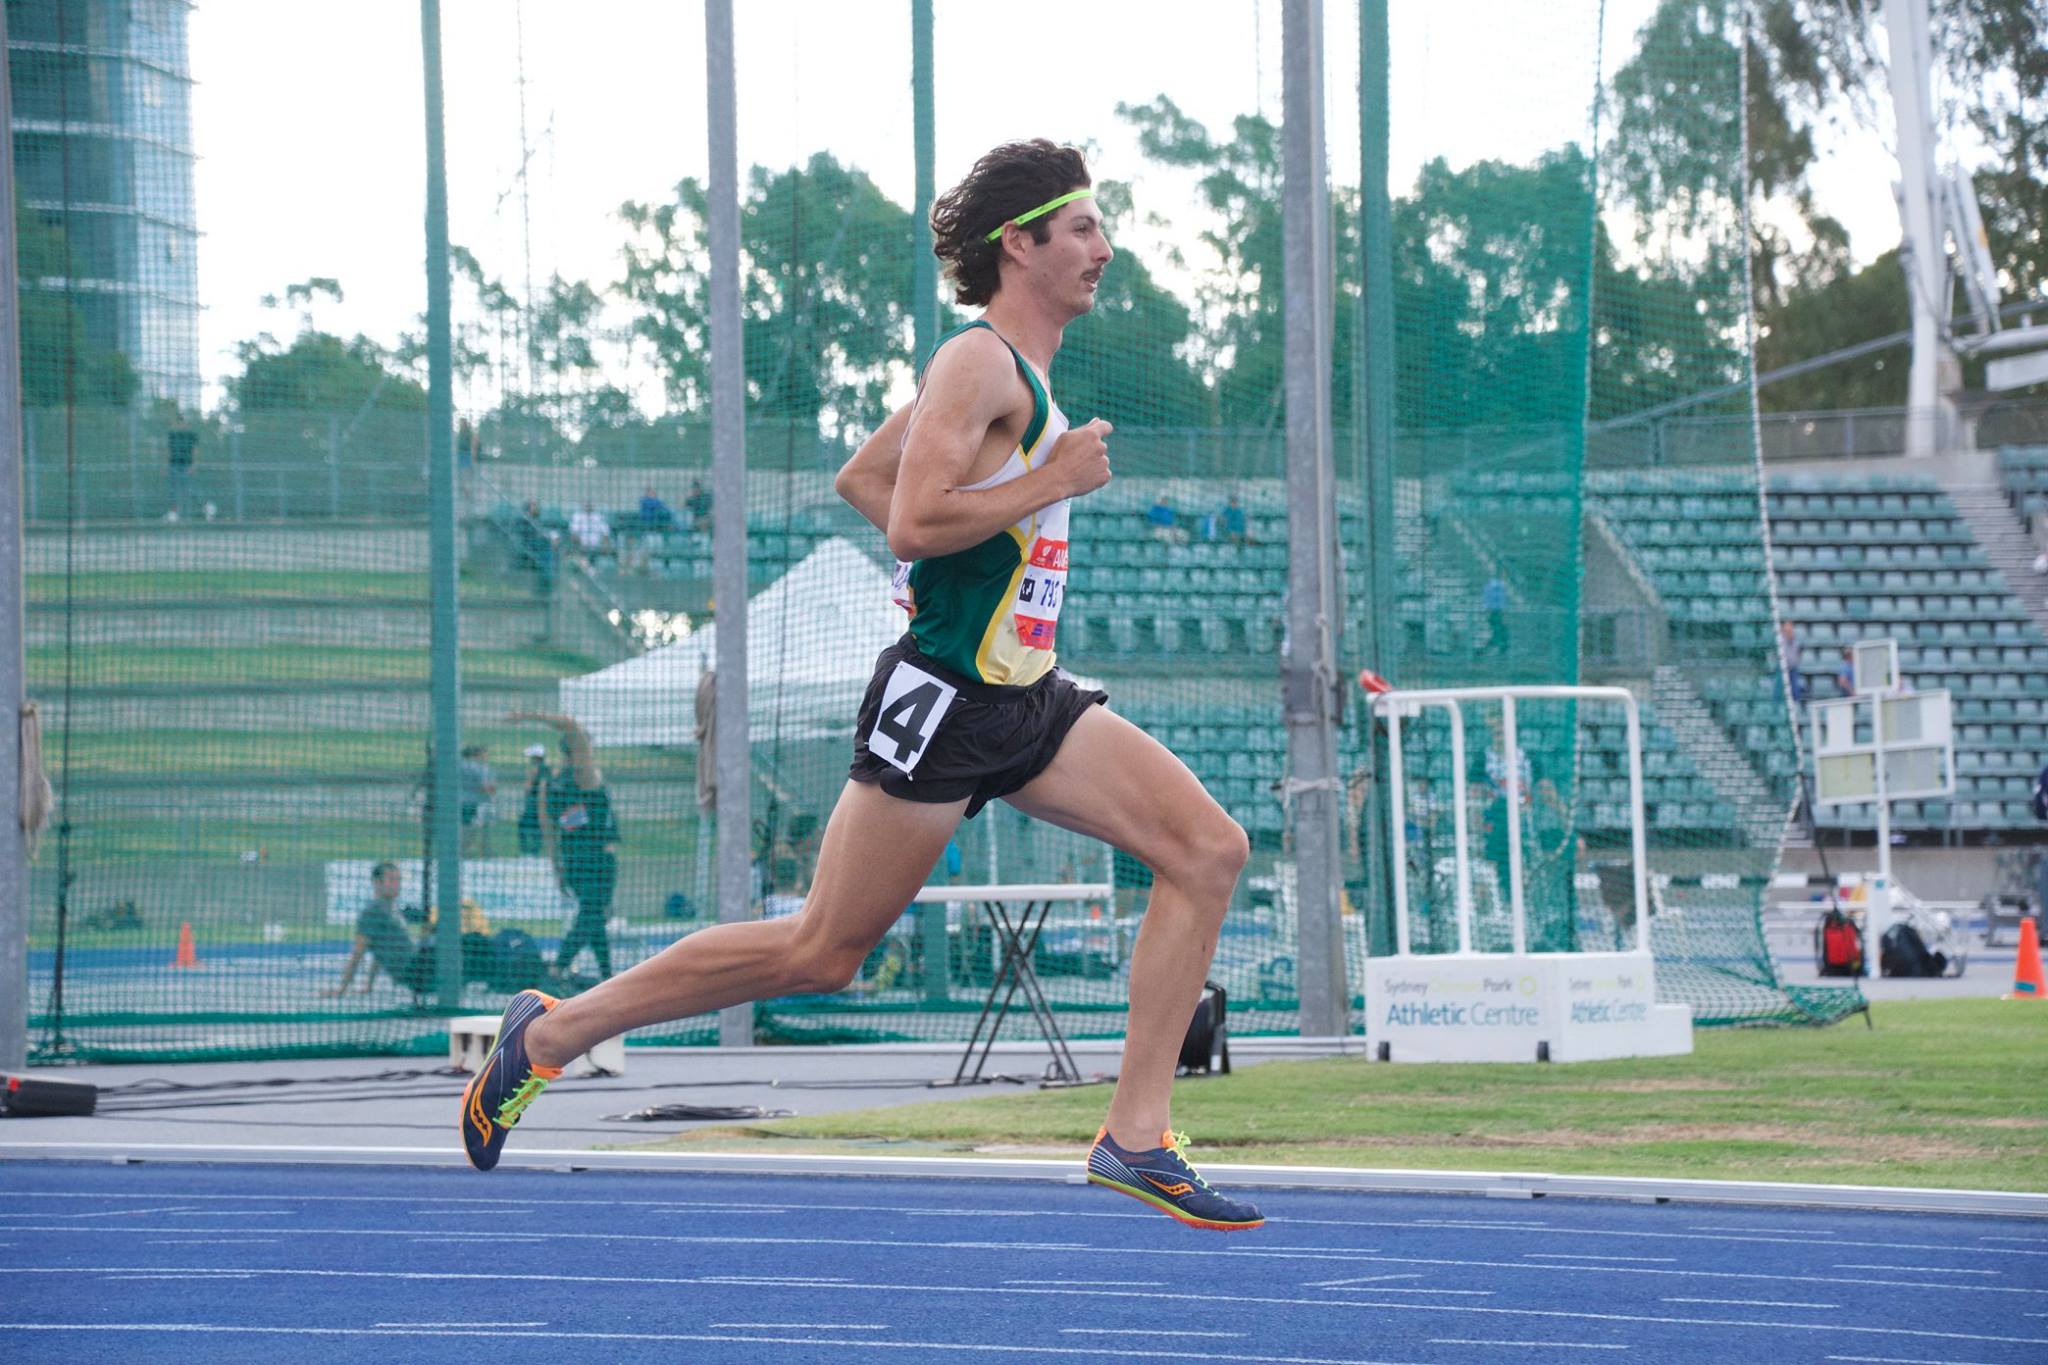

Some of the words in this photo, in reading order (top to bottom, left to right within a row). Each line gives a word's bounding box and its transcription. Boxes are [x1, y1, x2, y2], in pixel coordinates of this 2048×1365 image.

[877, 681, 943, 764] 4
[1483, 977, 1513, 991] Park
[1386, 1002, 1466, 1026] Athletic
[1471, 1002, 1538, 1026] Centre
